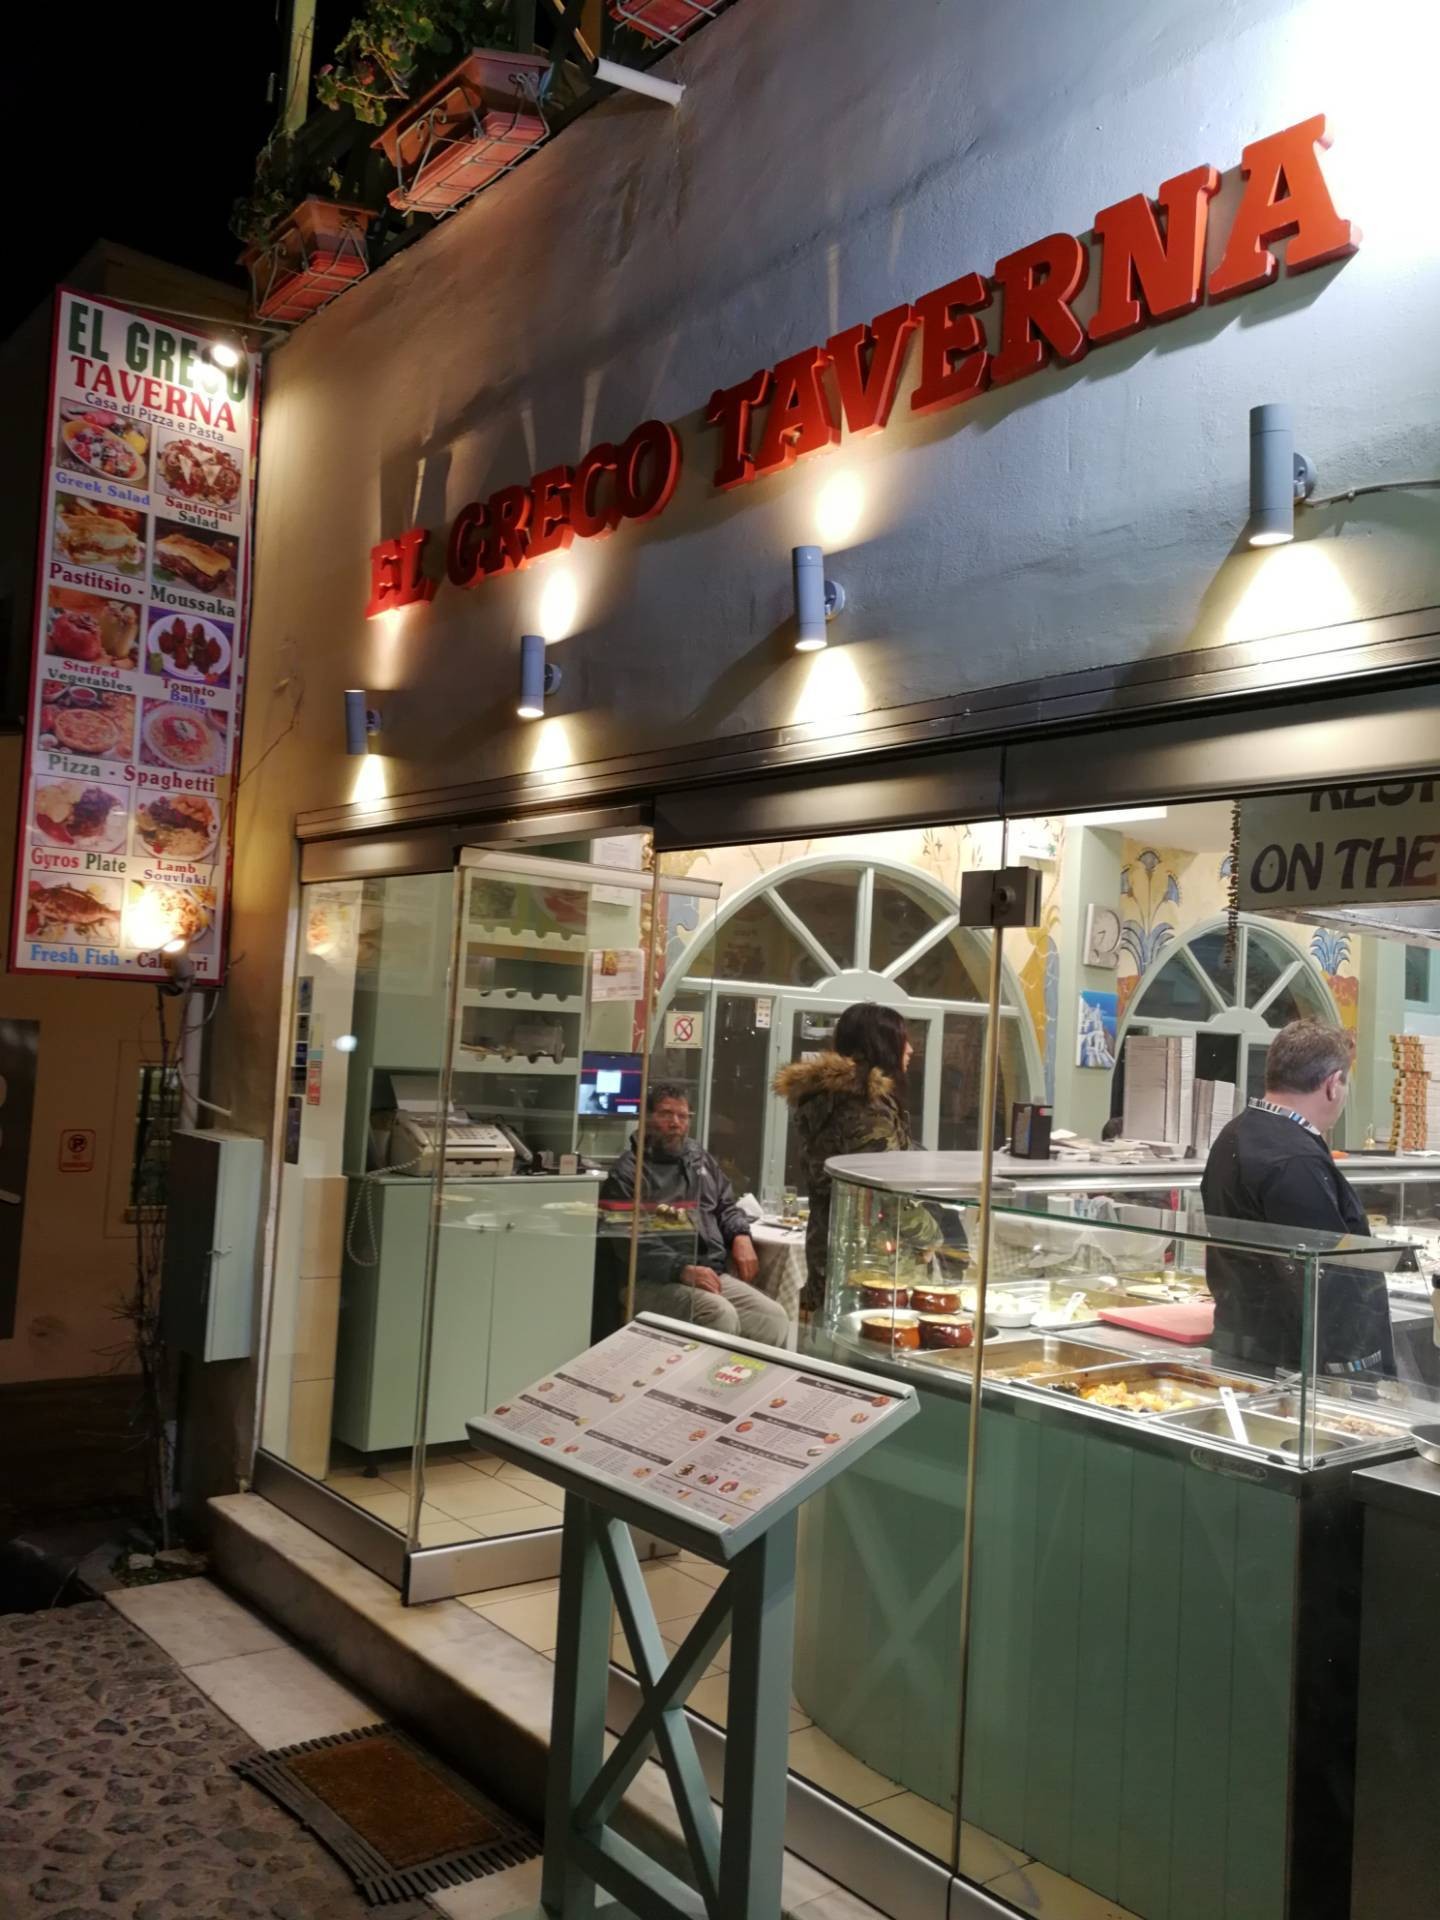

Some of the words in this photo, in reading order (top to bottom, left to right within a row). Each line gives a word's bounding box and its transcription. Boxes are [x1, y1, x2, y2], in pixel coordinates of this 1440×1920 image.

[68, 301, 110, 362] EL
[125, 321, 247, 403] GREO
[366, 527, 432, 620] EL
[447, 419, 682, 590] GRECO
[706, 113, 1362, 492] TAVERNA
[70, 354, 237, 433] TAVERNA
[84, 391, 119, 412] Casa
[121, 404, 137, 416] di
[139, 407, 175, 429] Pizza
[177, 421, 186, 431] e
[188, 423, 225, 442] Pasta
[55, 471, 104, 494] Greek
[106, 484, 151, 506] Salad
[164, 495, 233, 522] Santorini
[178, 510, 219, 530] Salad
[49, 562, 132, 595] Pastitsio
[150, 584, 237, 618] Moussaka
[47, 667, 133, 692] Vegetables
[63, 660, 121, 679] Stuffed
[161, 677, 216, 698] Tomato
[170, 689, 206, 706] Balls
[48, 754, 101, 777] Pizza
[123, 764, 216, 793] Spaghetti
[30, 847, 81, 870] Gyros
[84, 853, 127, 874] Plate
[156, 860, 197, 875] Lamb
[1250, 843, 1324, 894] ON
[1335, 834, 1440, 891] THE
[143, 868, 208, 886] Souvlaki
[29, 943, 80, 965] Fresh
[84, 948, 120, 967] Fish
